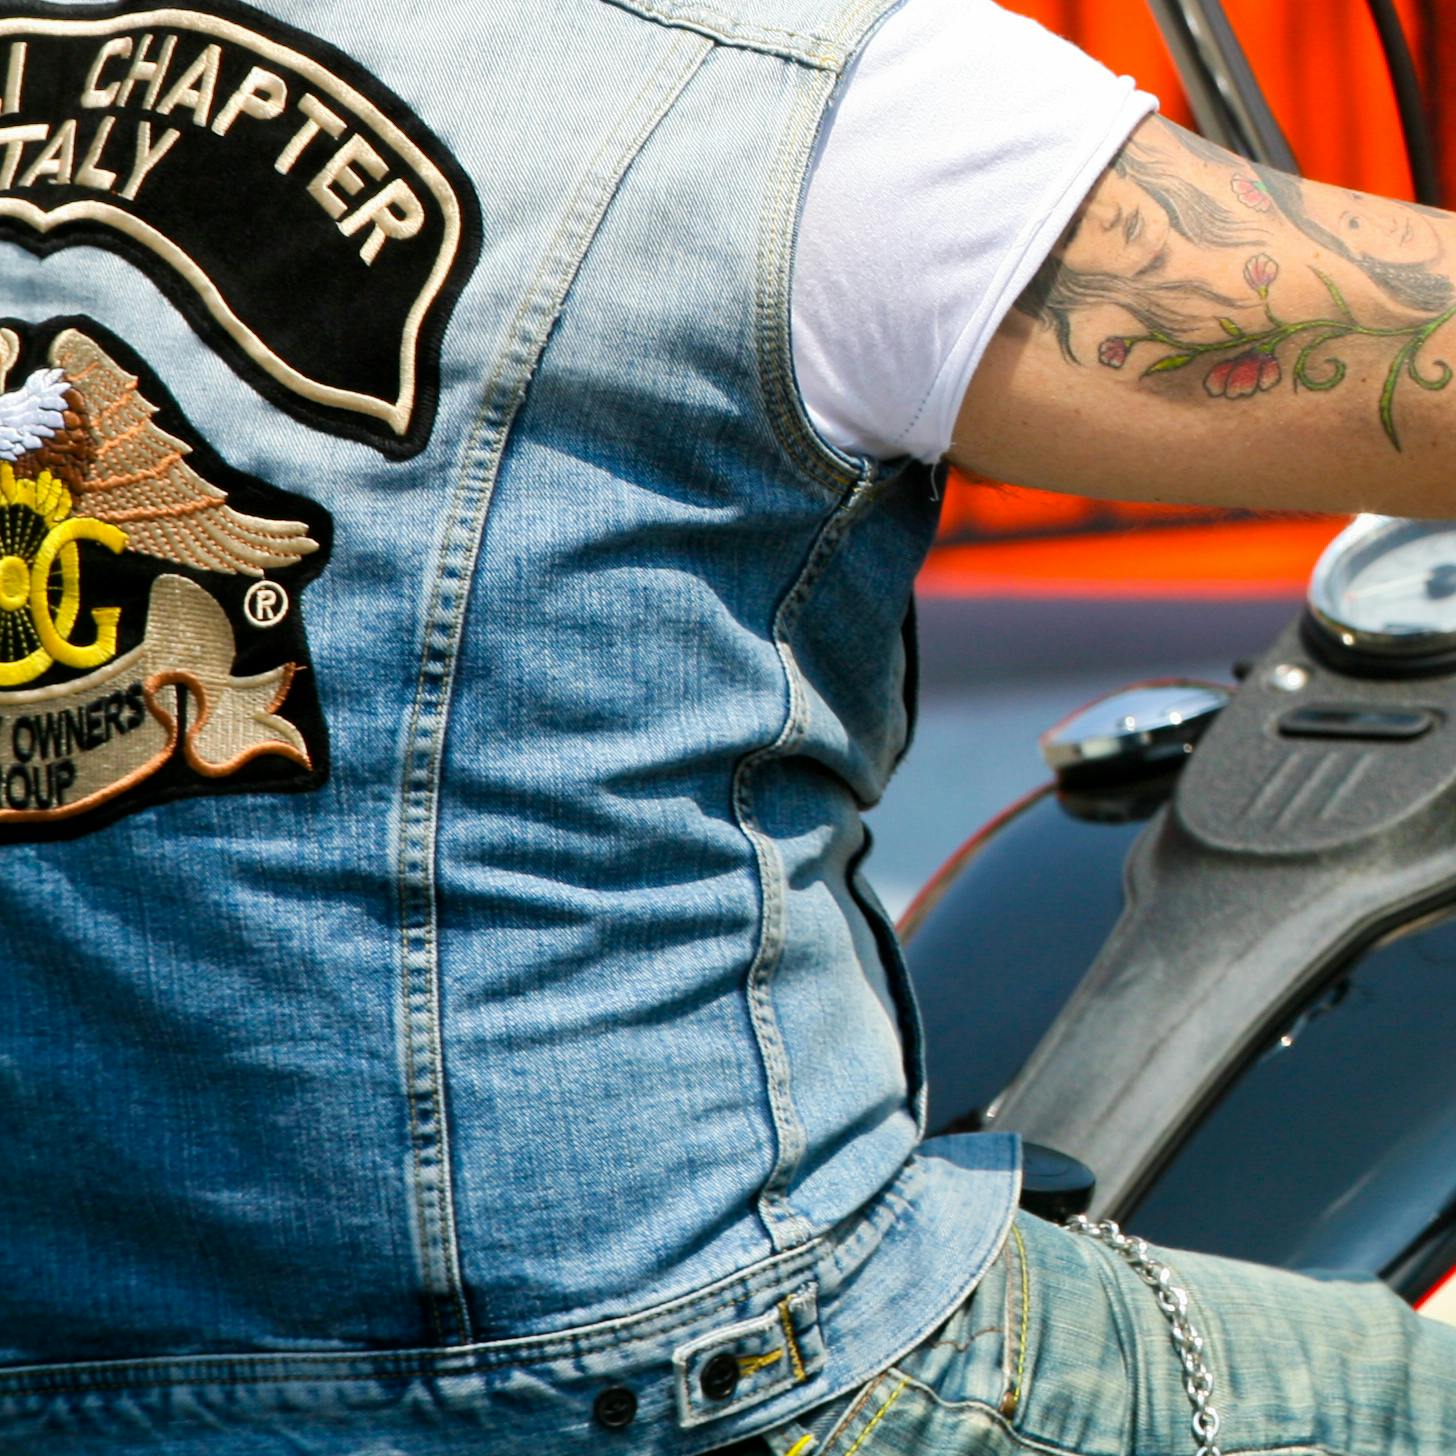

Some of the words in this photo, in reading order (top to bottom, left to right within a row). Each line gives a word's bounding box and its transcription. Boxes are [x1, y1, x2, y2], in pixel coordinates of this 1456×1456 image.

[81, 34, 425, 266] CHAPTER
[13, 679, 145, 763] OWNERS
[0, 757, 76, 810] OUP
